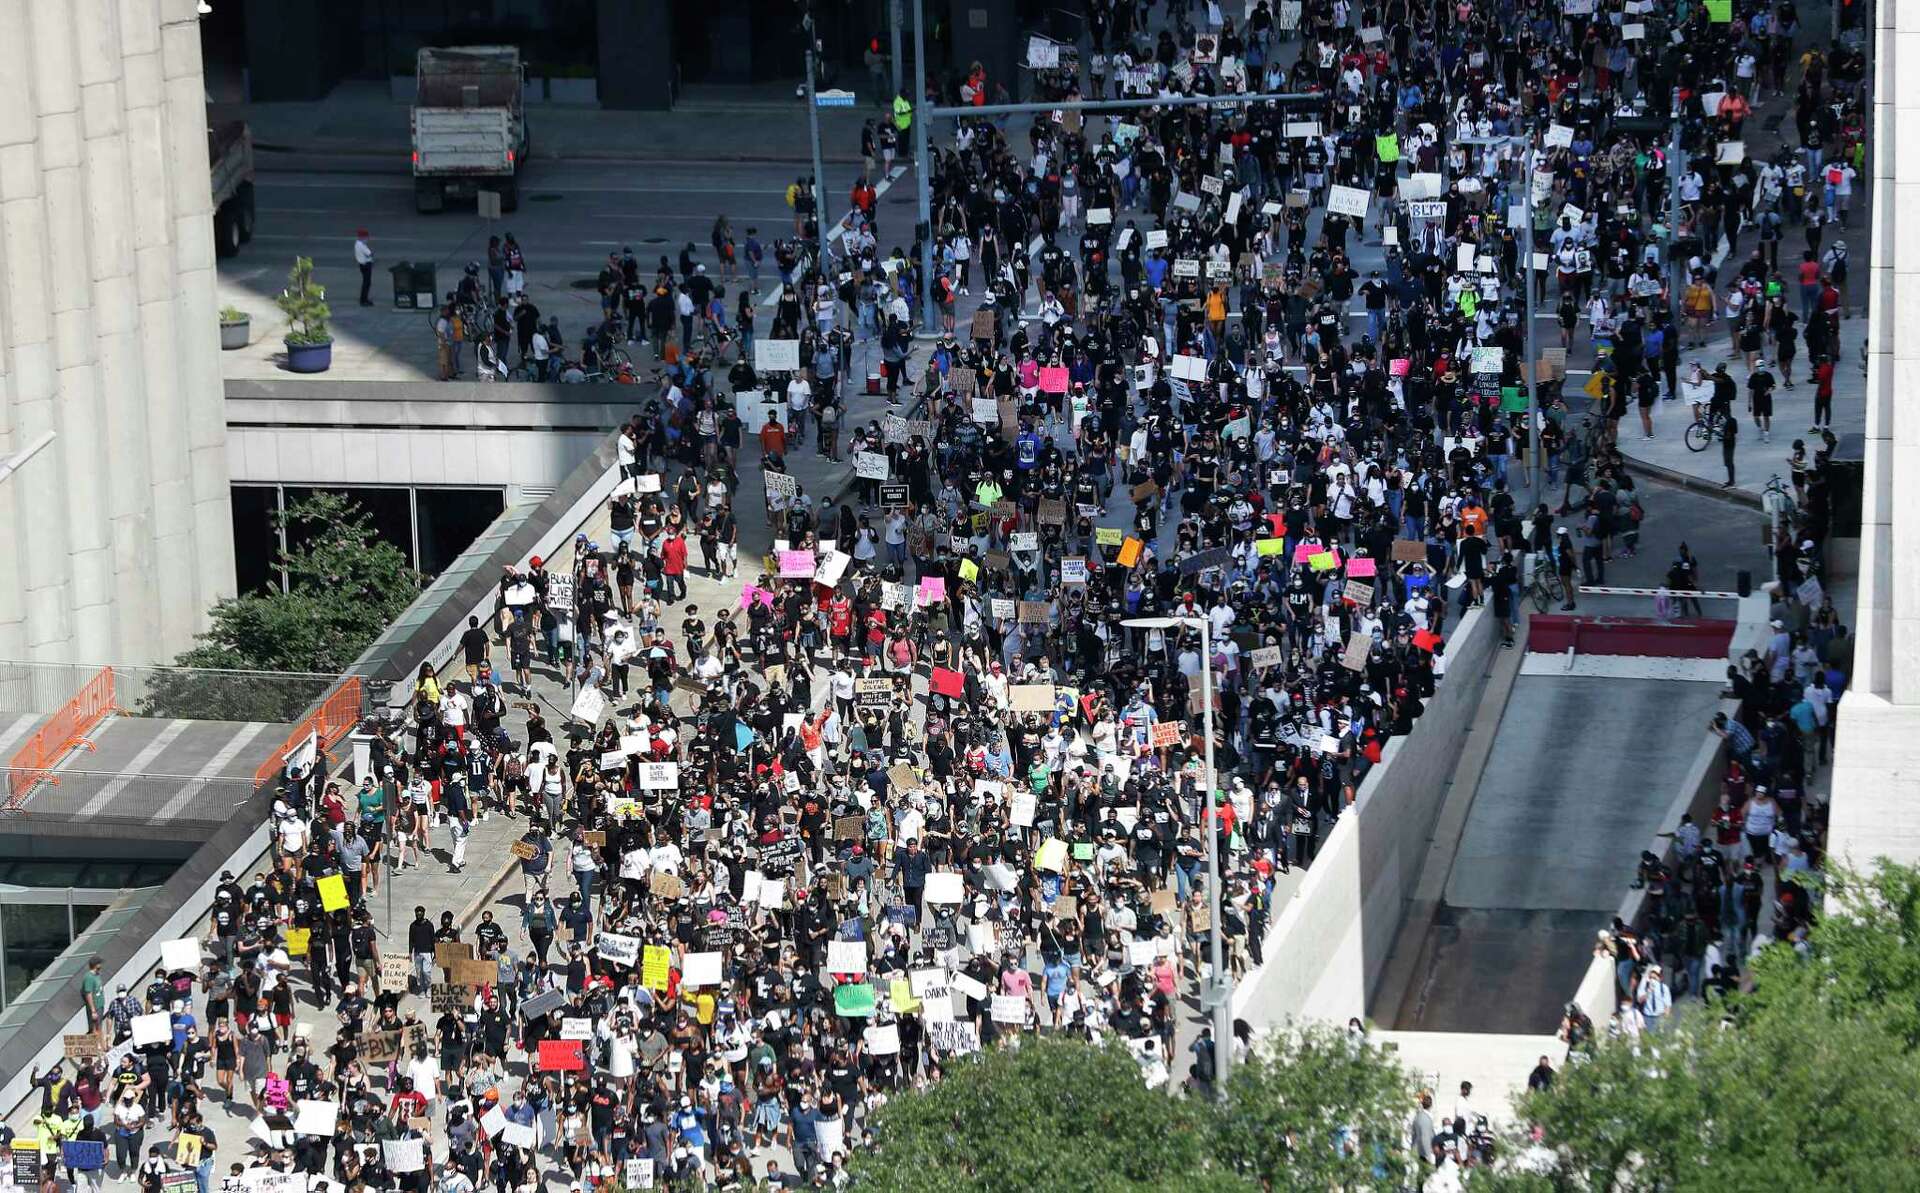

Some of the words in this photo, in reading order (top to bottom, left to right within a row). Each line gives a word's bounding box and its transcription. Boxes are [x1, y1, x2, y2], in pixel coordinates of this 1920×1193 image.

[816, 97, 855, 106] Louisiana
[1412, 204, 1444, 216] BLM
[767, 472, 795, 485] BLACK
[550, 573, 574, 584] BLACK
[1289, 593, 1308, 604] BLM
[1152, 723, 1176, 732] BLACK
[472, 762, 482, 774] 11
[776, 838, 797, 849] NEVER
[383, 962, 401, 970] FOR
[430, 983, 469, 996] BLACK
[925, 986, 949, 999] DARK
[932, 1021, 942, 1030] NO
[273, 1080, 281, 1088] I
[222, 1179, 252, 1193] Justice
